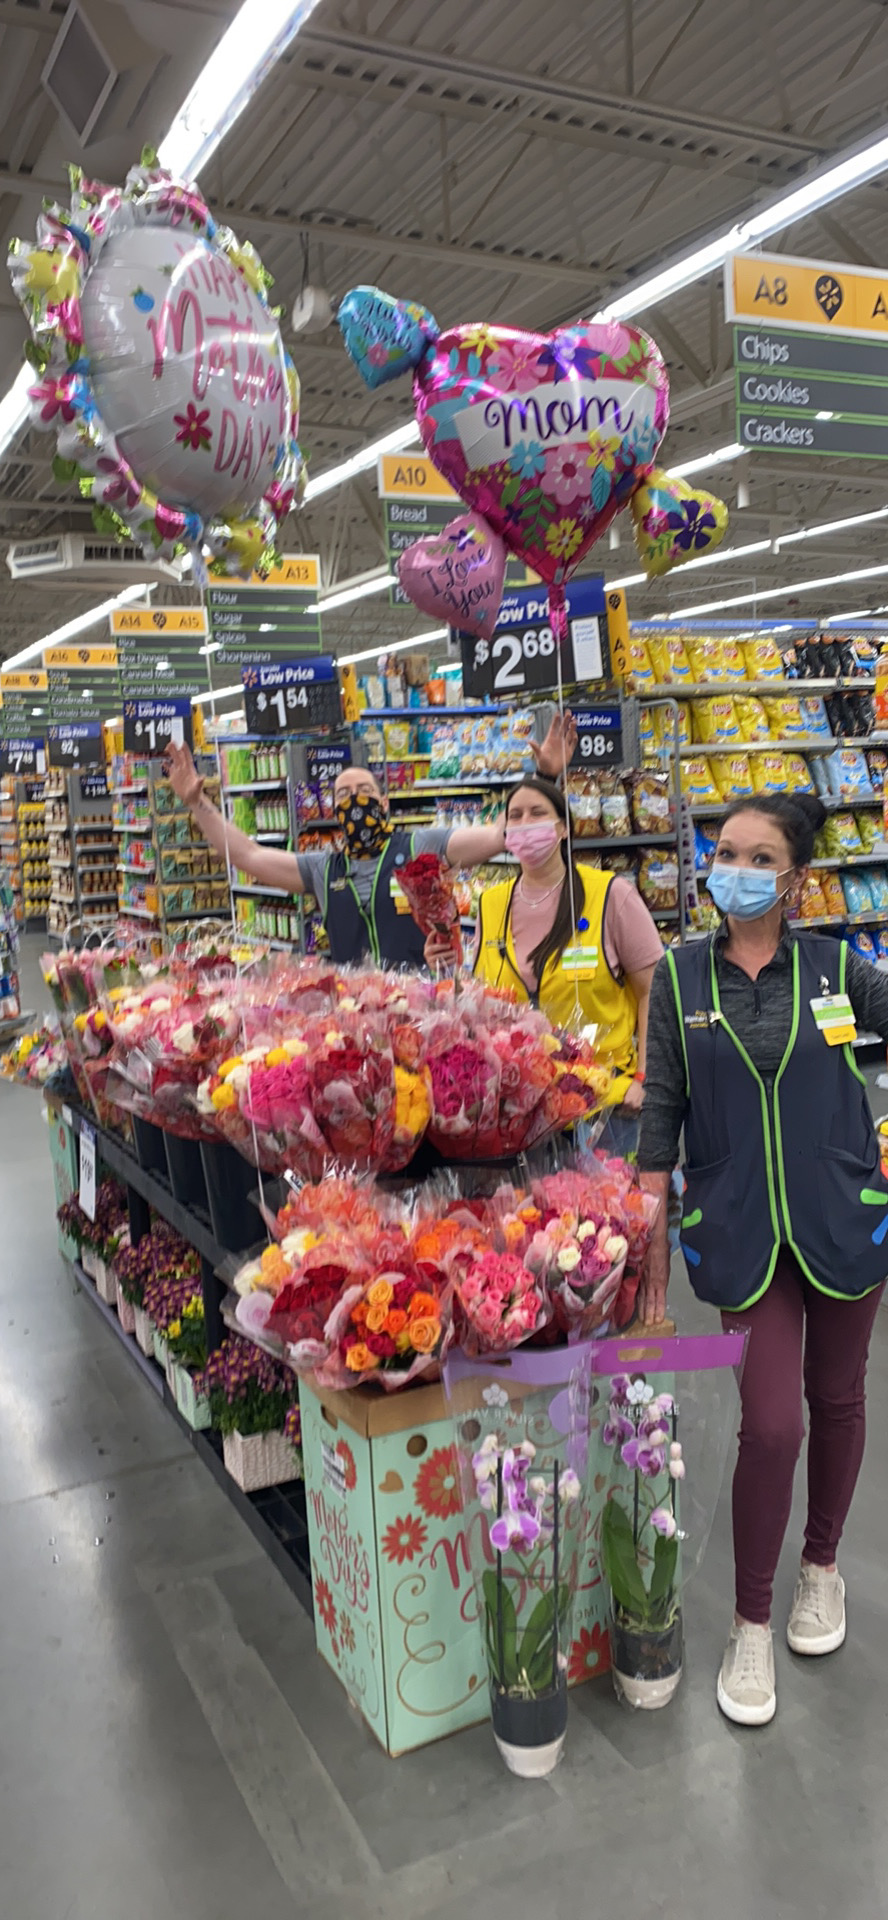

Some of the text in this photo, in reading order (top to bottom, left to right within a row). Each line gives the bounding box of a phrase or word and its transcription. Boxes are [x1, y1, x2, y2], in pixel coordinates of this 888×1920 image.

[753, 274, 789, 306] A8
[741, 335, 790, 366] Chips
[743, 377, 810, 405] Cookies
[743, 418, 815, 446] Crackers
[214, 408, 271, 483] DAY
[392, 466, 427, 486] A10
[390, 505, 428, 522] Bread
[285, 565, 309, 580] A13
[421, 548, 492, 598] I Love
[212, 591, 238, 605] Flour
[443, 580, 495, 618] You
[119, 616, 200, 628] A14 A15
[213, 612, 242, 625] Sugar
[495, 606, 525, 626] ow
[215, 631, 246, 645] Spices
[260, 666, 315, 686] Low Price
[138, 703, 176, 717] Low Price
[576, 717, 592, 727] Low
[593, 715, 612, 726] Price
